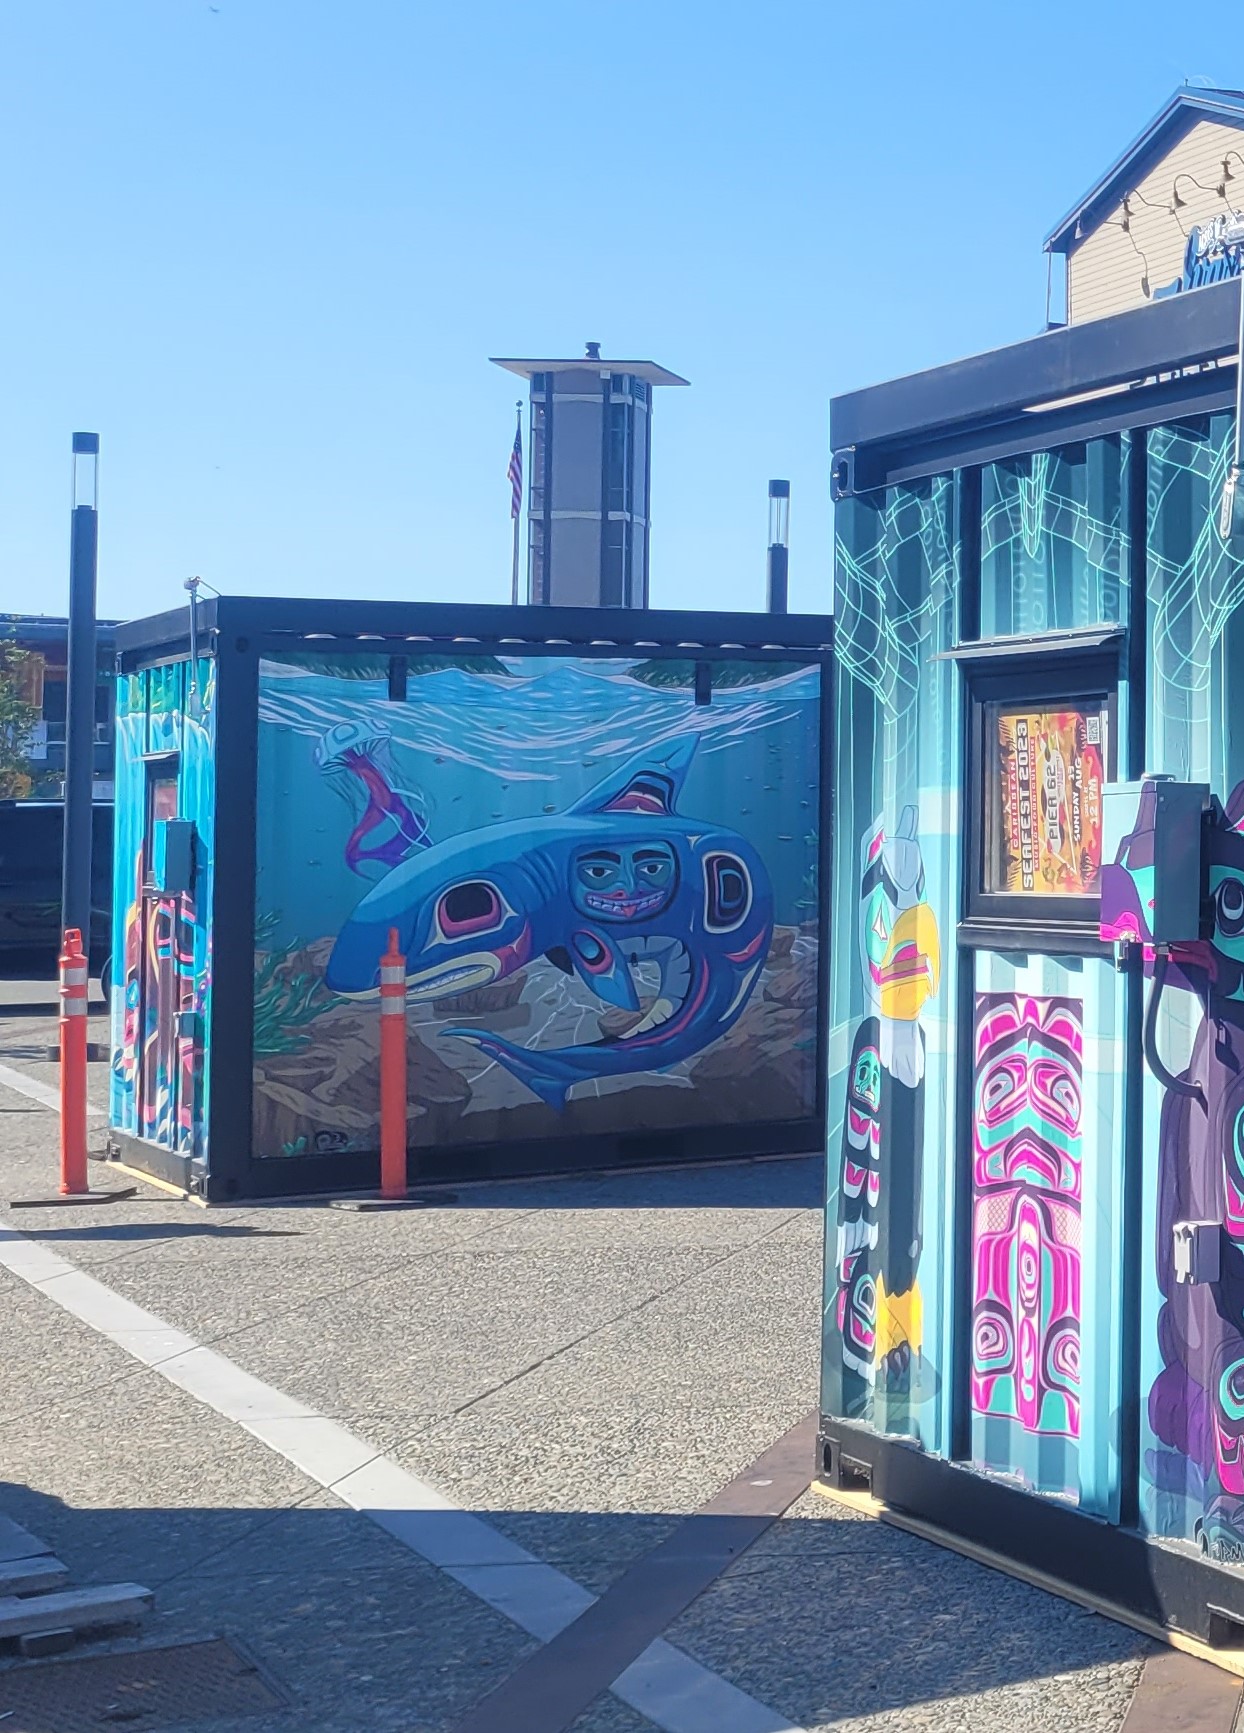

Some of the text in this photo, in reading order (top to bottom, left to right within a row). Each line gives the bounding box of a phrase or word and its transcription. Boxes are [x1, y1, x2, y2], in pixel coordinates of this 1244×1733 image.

[1010, 761, 1019, 848] CARIBBEAN
[1017, 722, 1033, 888] SEAFEST 2023
[1046, 764, 1058, 840] PIER 62
[1072, 757, 1084, 842] SUNDAY AUG
[1087, 777, 1098, 801] PM
